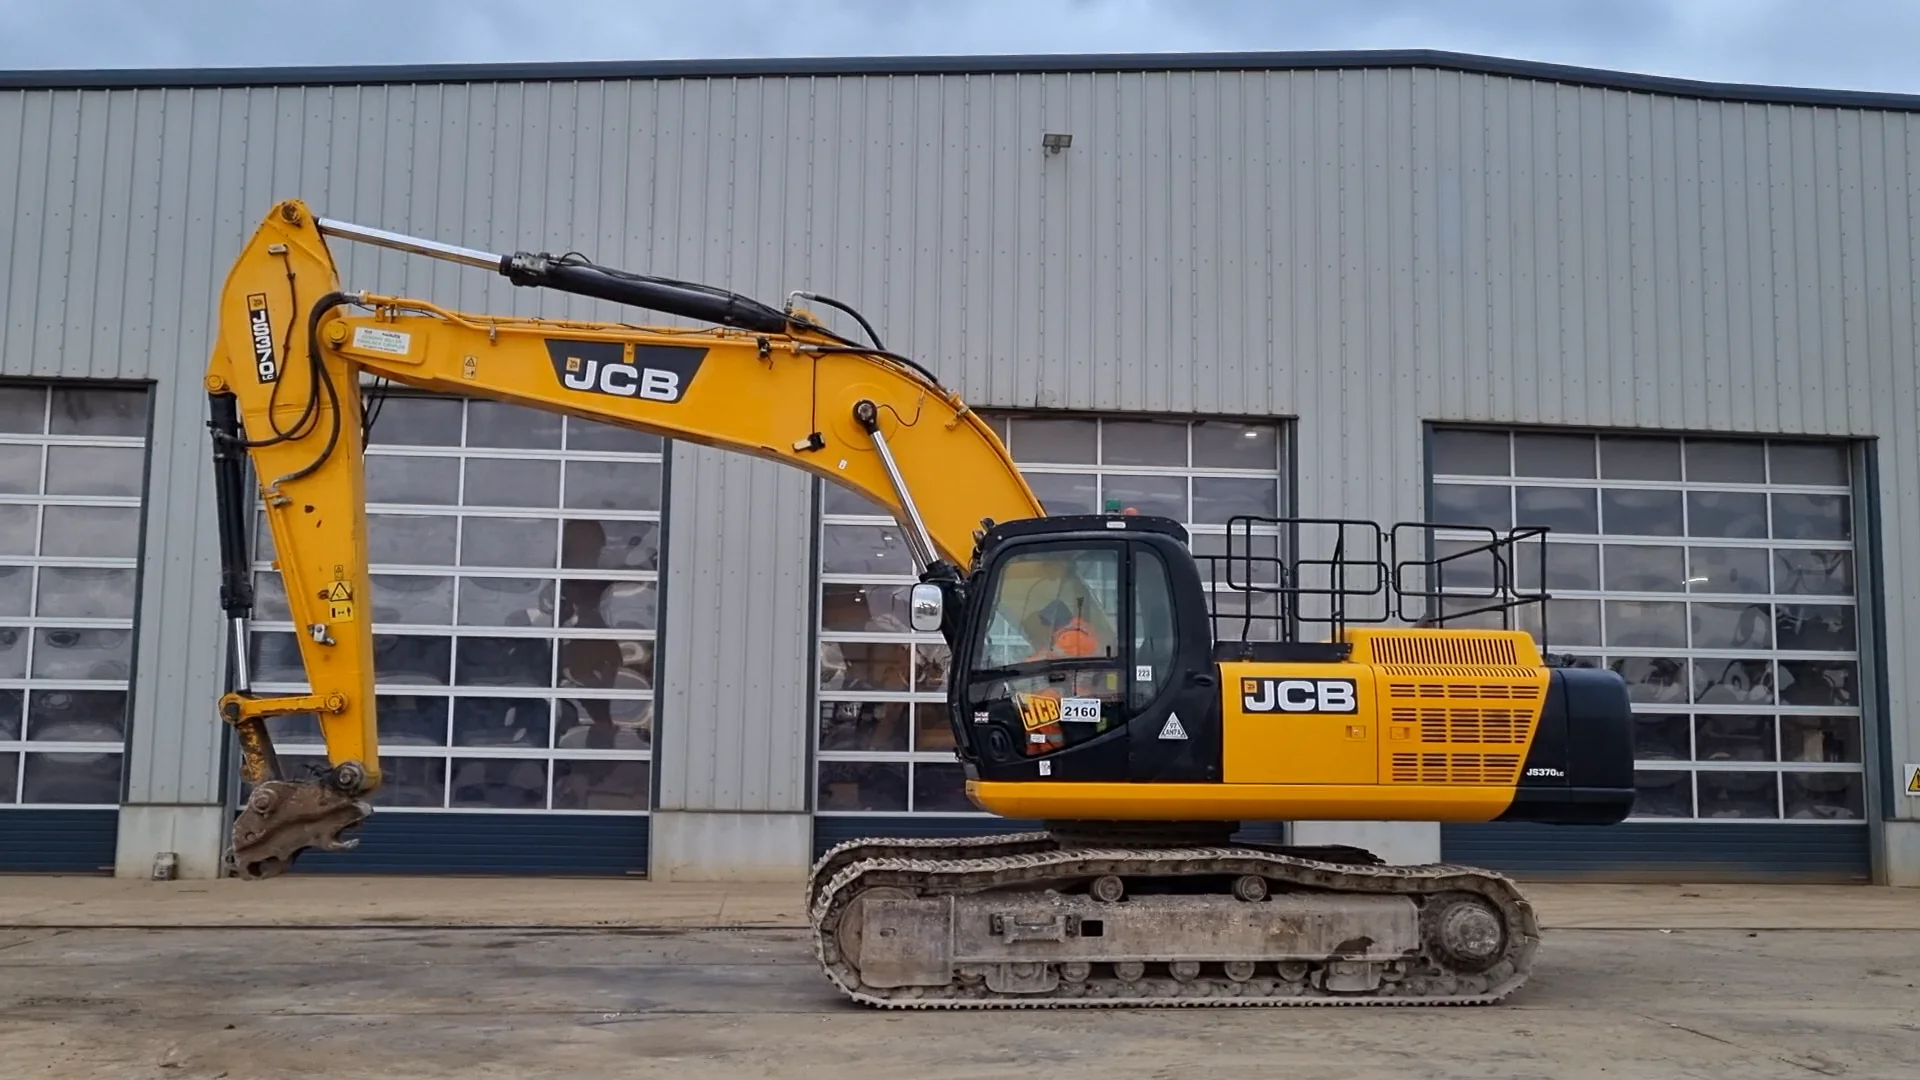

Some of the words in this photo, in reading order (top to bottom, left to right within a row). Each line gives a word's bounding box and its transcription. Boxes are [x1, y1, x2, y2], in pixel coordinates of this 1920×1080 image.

[565, 360, 678, 401] JCB
[1023, 695, 1059, 727] JCB
[1244, 680, 1356, 711] JCB
[1064, 706, 1097, 718] 2160
[1526, 768, 1565, 777] JS370LC
